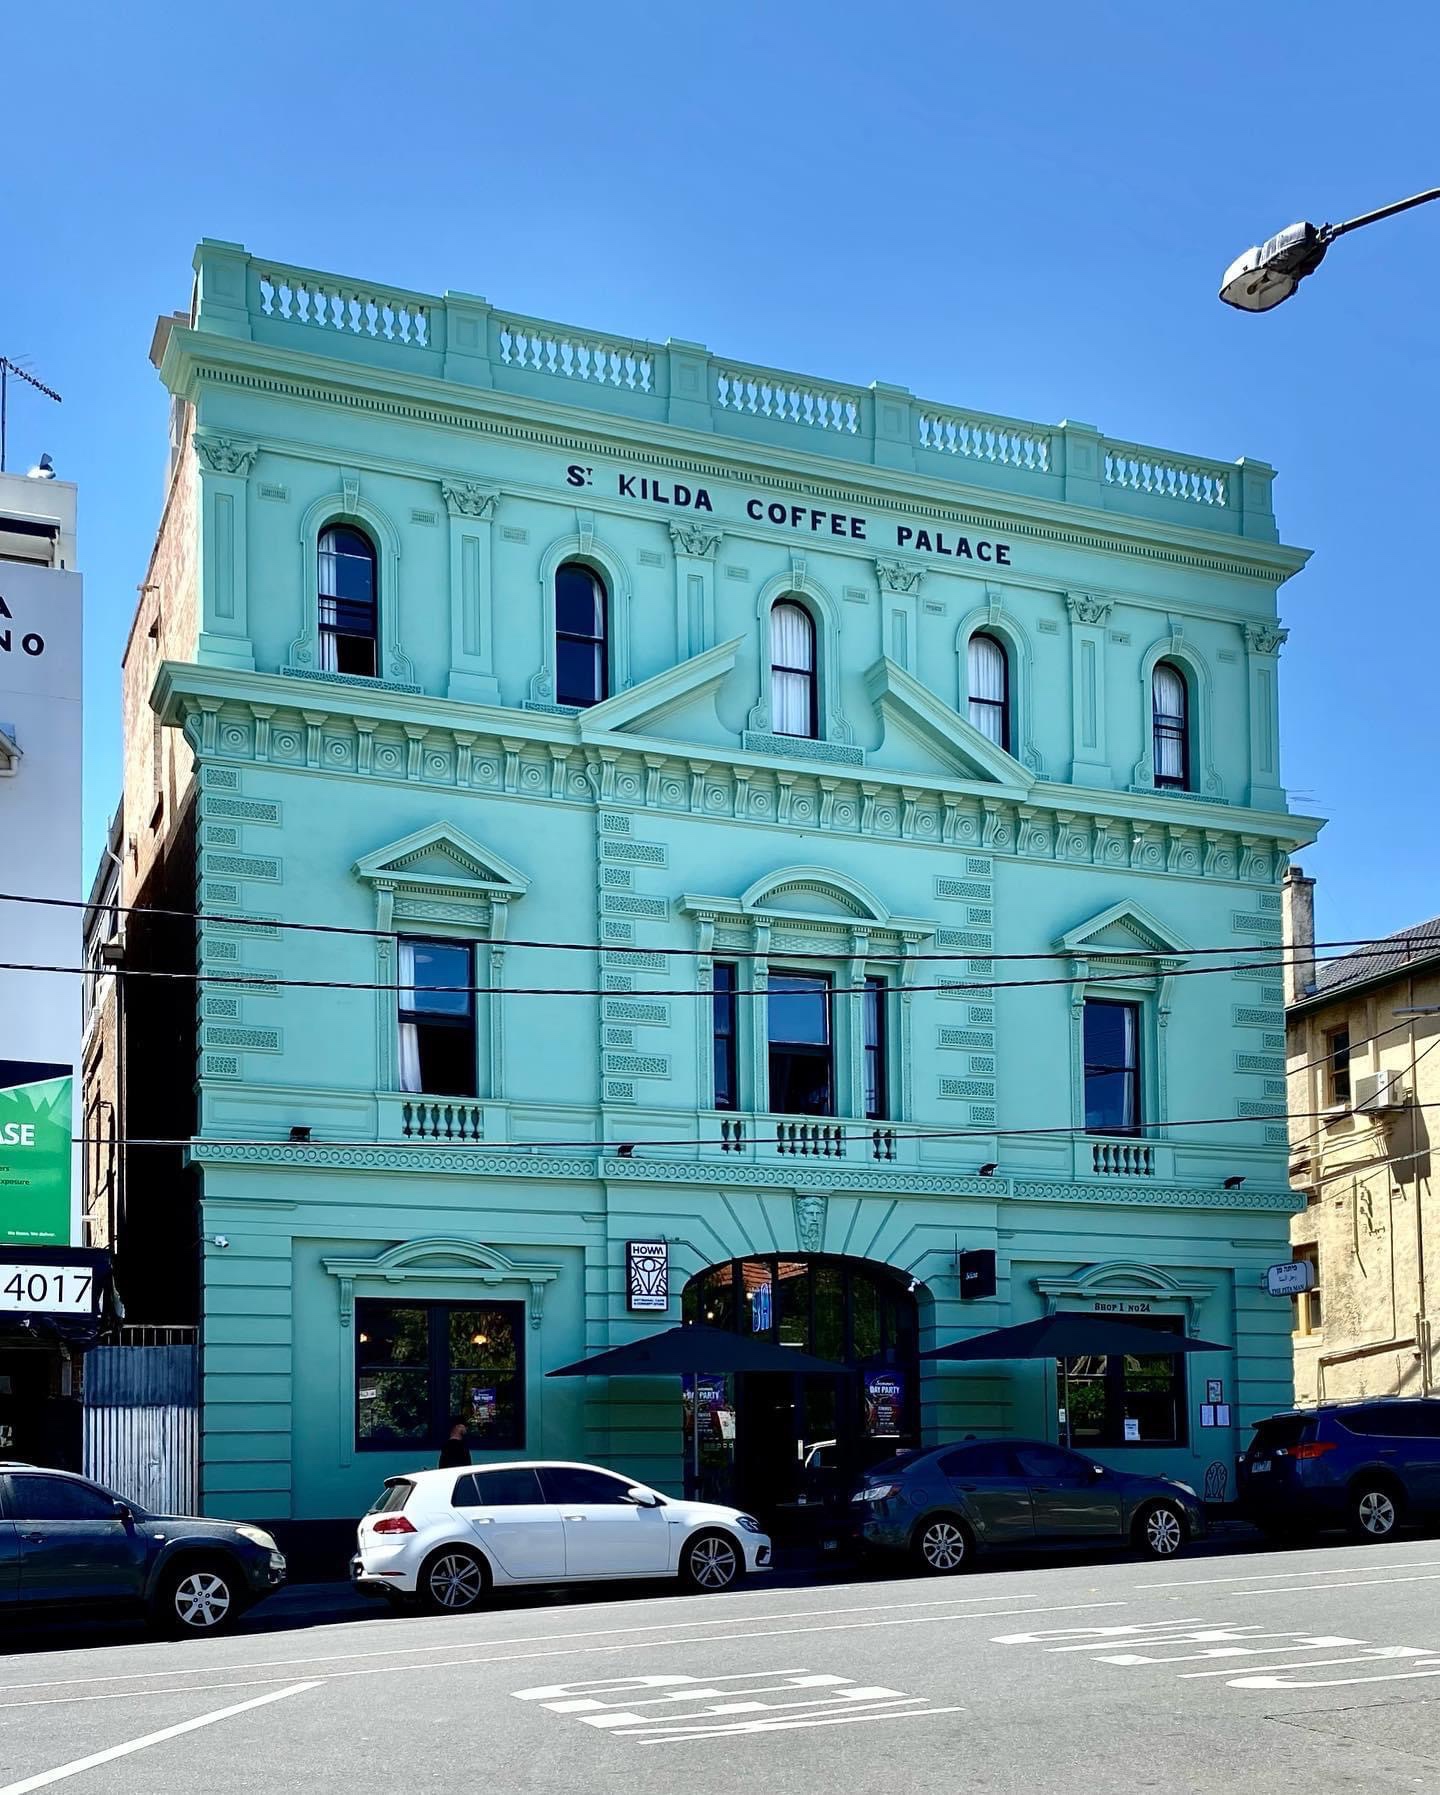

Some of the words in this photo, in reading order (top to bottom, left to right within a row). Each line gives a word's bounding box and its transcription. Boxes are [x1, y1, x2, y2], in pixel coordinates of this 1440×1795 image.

[619, 473, 713, 512] KILDA
[746, 499, 866, 539] COFFEE
[897, 525, 1011, 566] PALACE
[4, 1273, 92, 1303] 4017
[510, 1668, 967, 1745] KEEP
